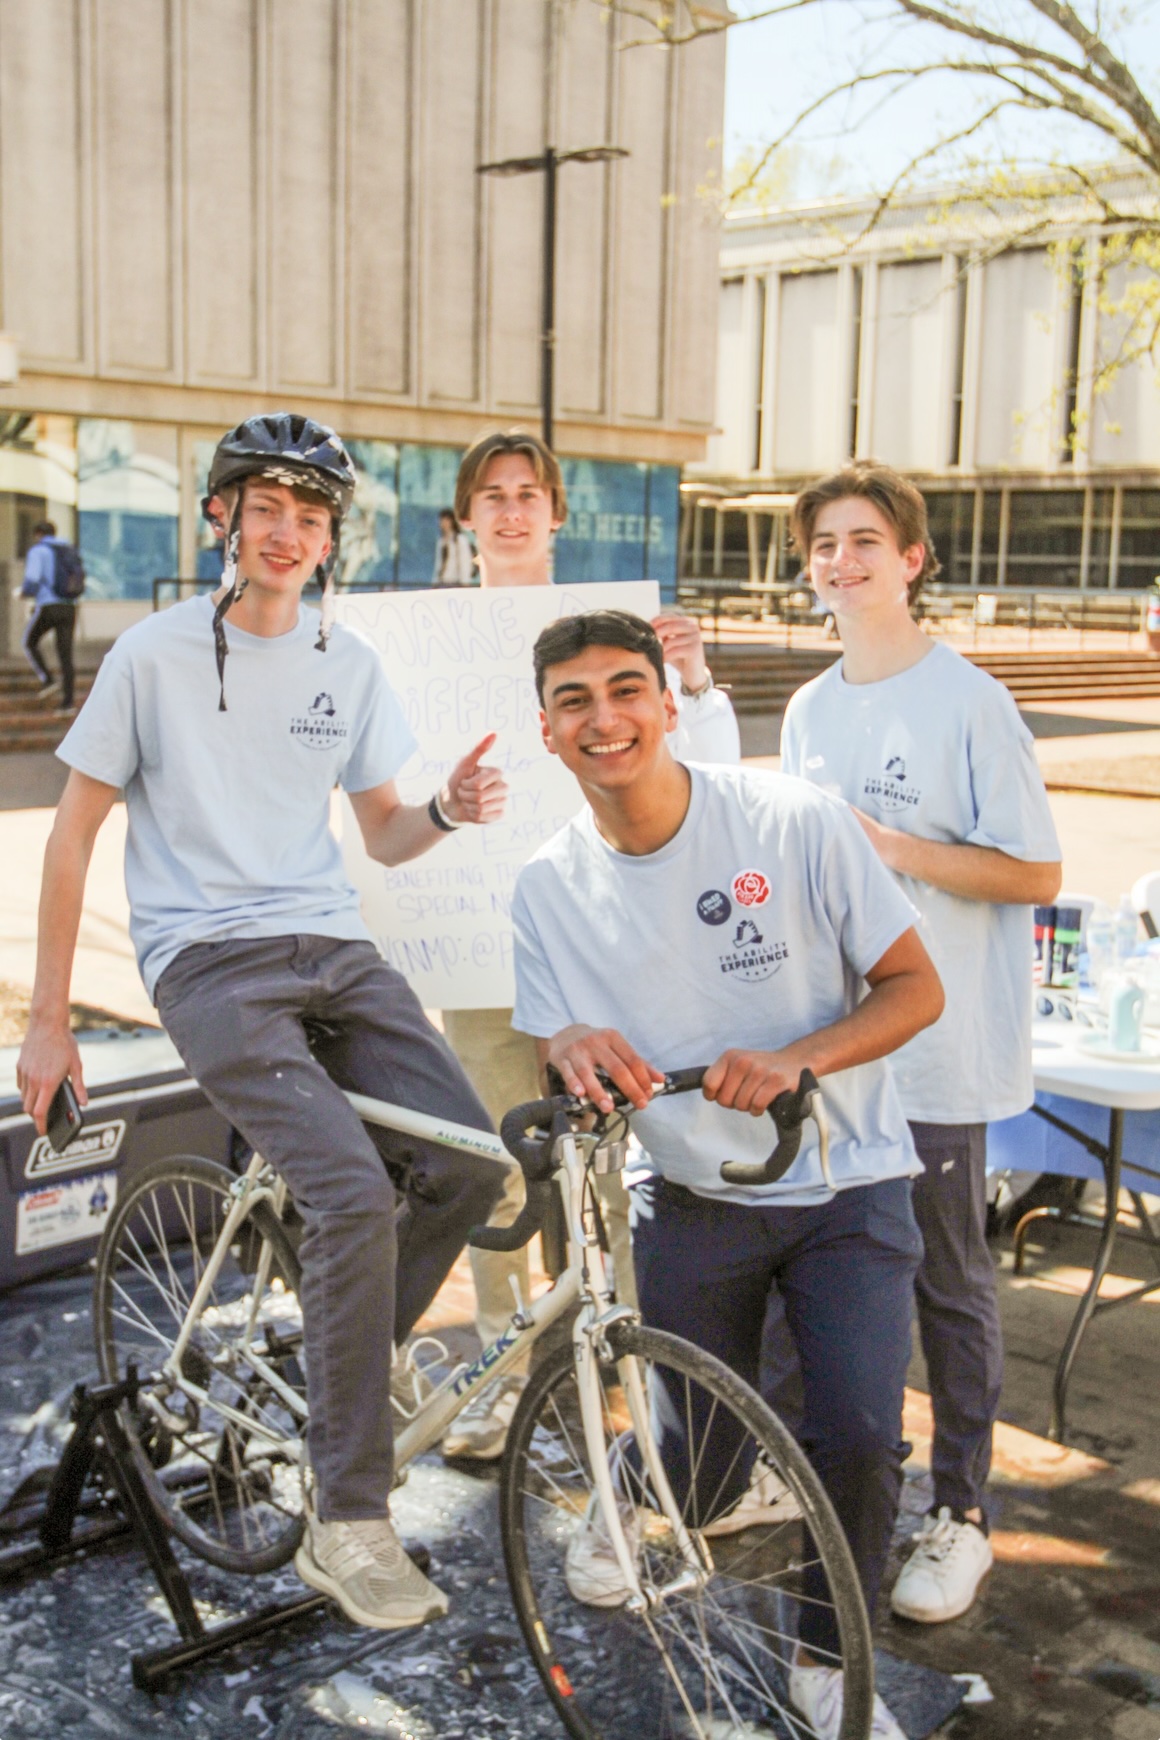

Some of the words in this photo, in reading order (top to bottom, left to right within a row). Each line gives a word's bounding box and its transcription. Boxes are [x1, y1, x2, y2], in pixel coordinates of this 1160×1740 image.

[290, 726, 348, 738] EXPERIENCE
[396, 892, 486, 923] SPECIAL
[719, 952, 738, 963] THE
[743, 941, 788, 958] ABILITY
[721, 948, 789, 973] EXPERIENCE
[436, 1130, 502, 1153] ALUMINUM
[449, 1326, 518, 1396] TREK
